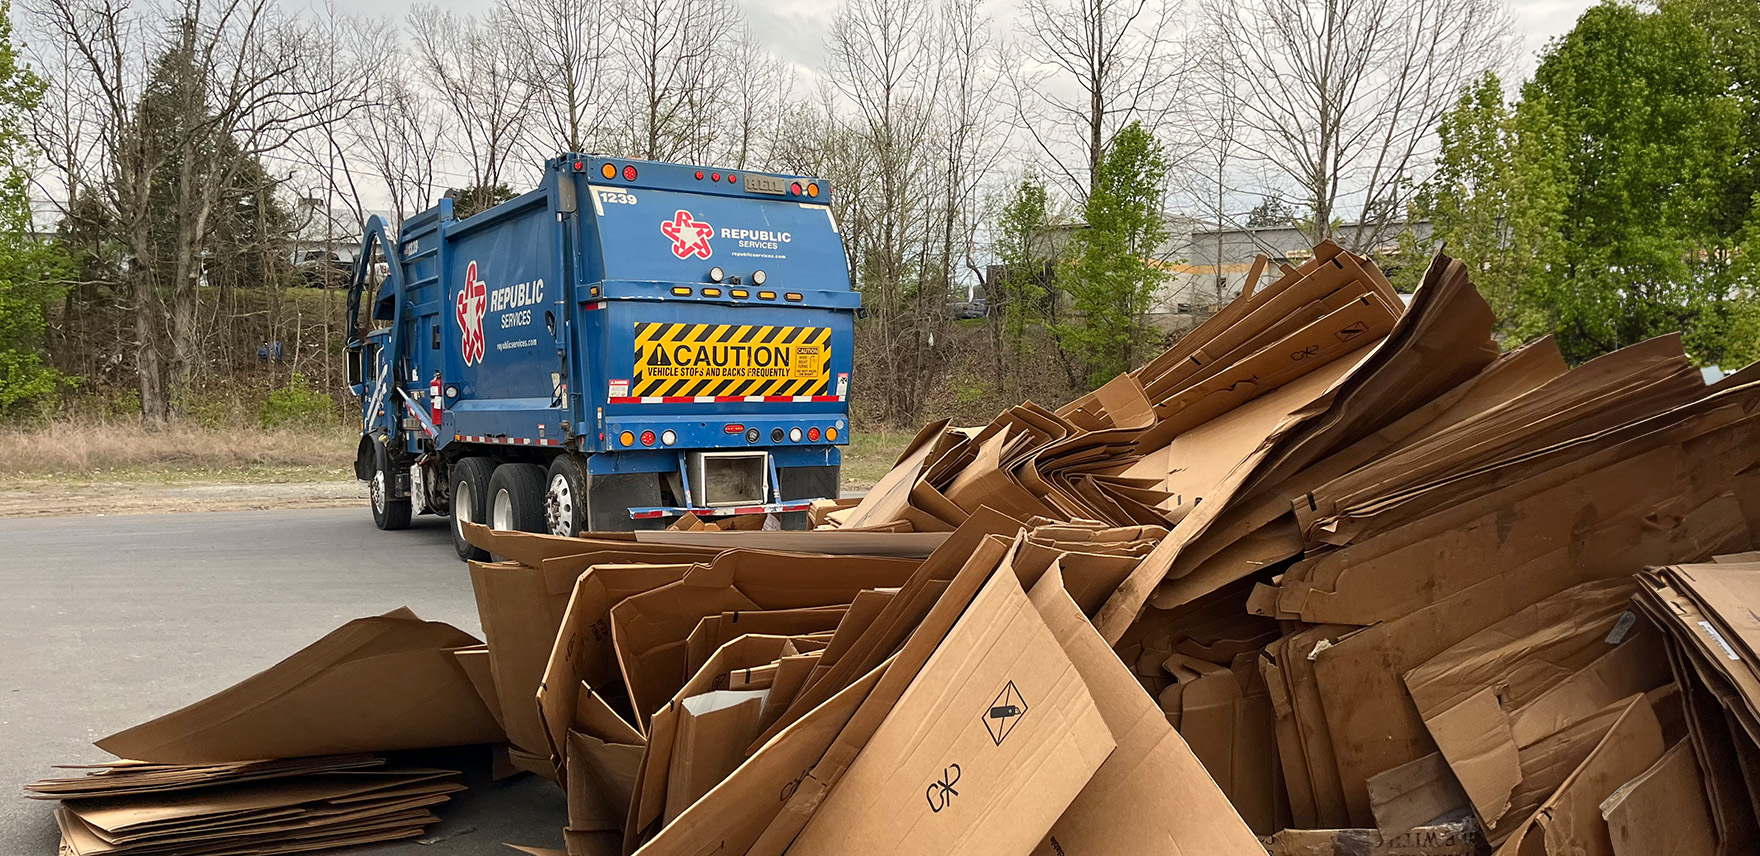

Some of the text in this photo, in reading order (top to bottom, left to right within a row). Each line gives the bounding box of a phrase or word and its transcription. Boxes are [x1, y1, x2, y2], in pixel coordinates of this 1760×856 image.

[746, 178, 783, 192] HEIL
[601, 192, 637, 205] 1239
[721, 228, 792, 243] REPUBLIC
[738, 240, 778, 250] SERVICES
[490, 279, 544, 312] REPUBLIC
[501, 310, 531, 329] SERVICES
[673, 344, 790, 367] CAUTION
[648, 367, 679, 377] VEHICLE
[706, 367, 720, 377] AND
[722, 367, 746, 377] BACKS
[747, 367, 790, 378] FREQUENTLY
